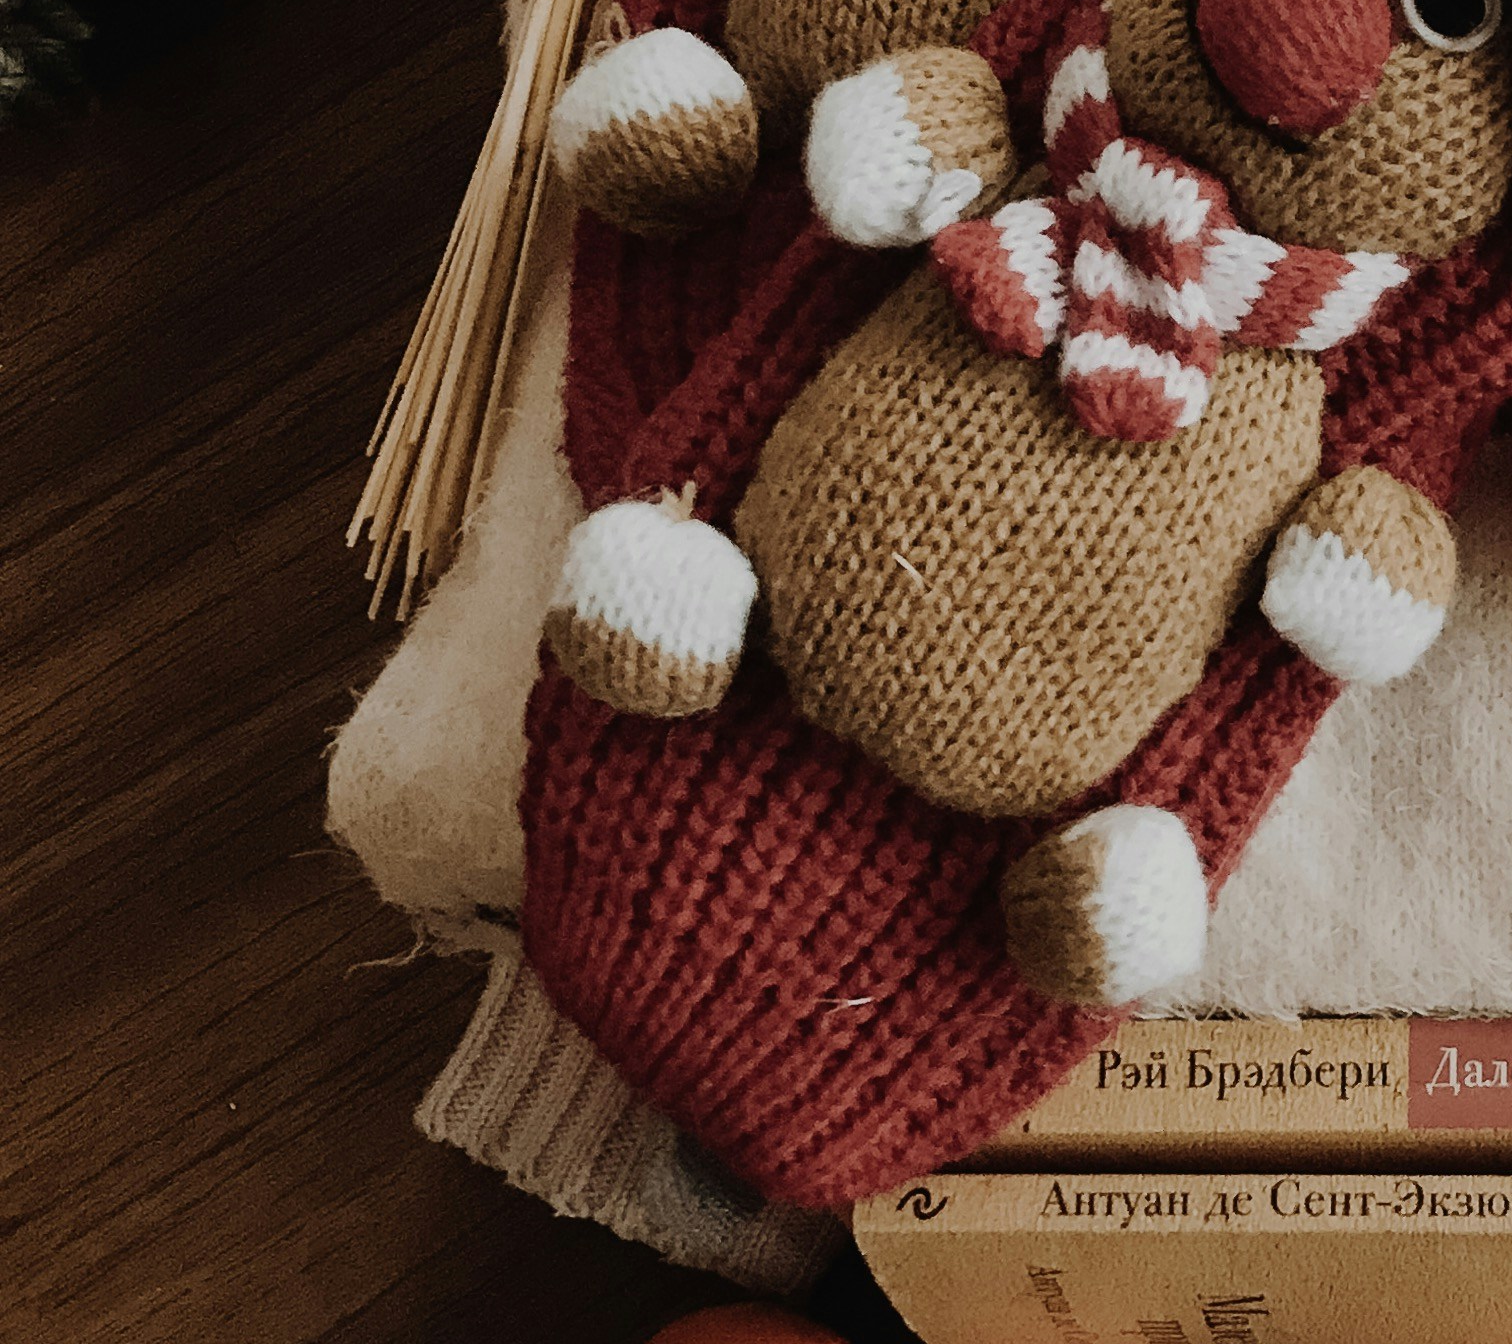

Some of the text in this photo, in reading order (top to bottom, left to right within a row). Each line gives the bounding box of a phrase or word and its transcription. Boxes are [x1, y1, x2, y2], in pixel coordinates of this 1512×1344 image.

[1096, 1050, 1168, 1090] Рэй
[1186, 1049, 1390, 1100] Брэдбери
[1040, 1181, 1190, 1229] Антуан
[1203, 1190, 1254, 1222] де
